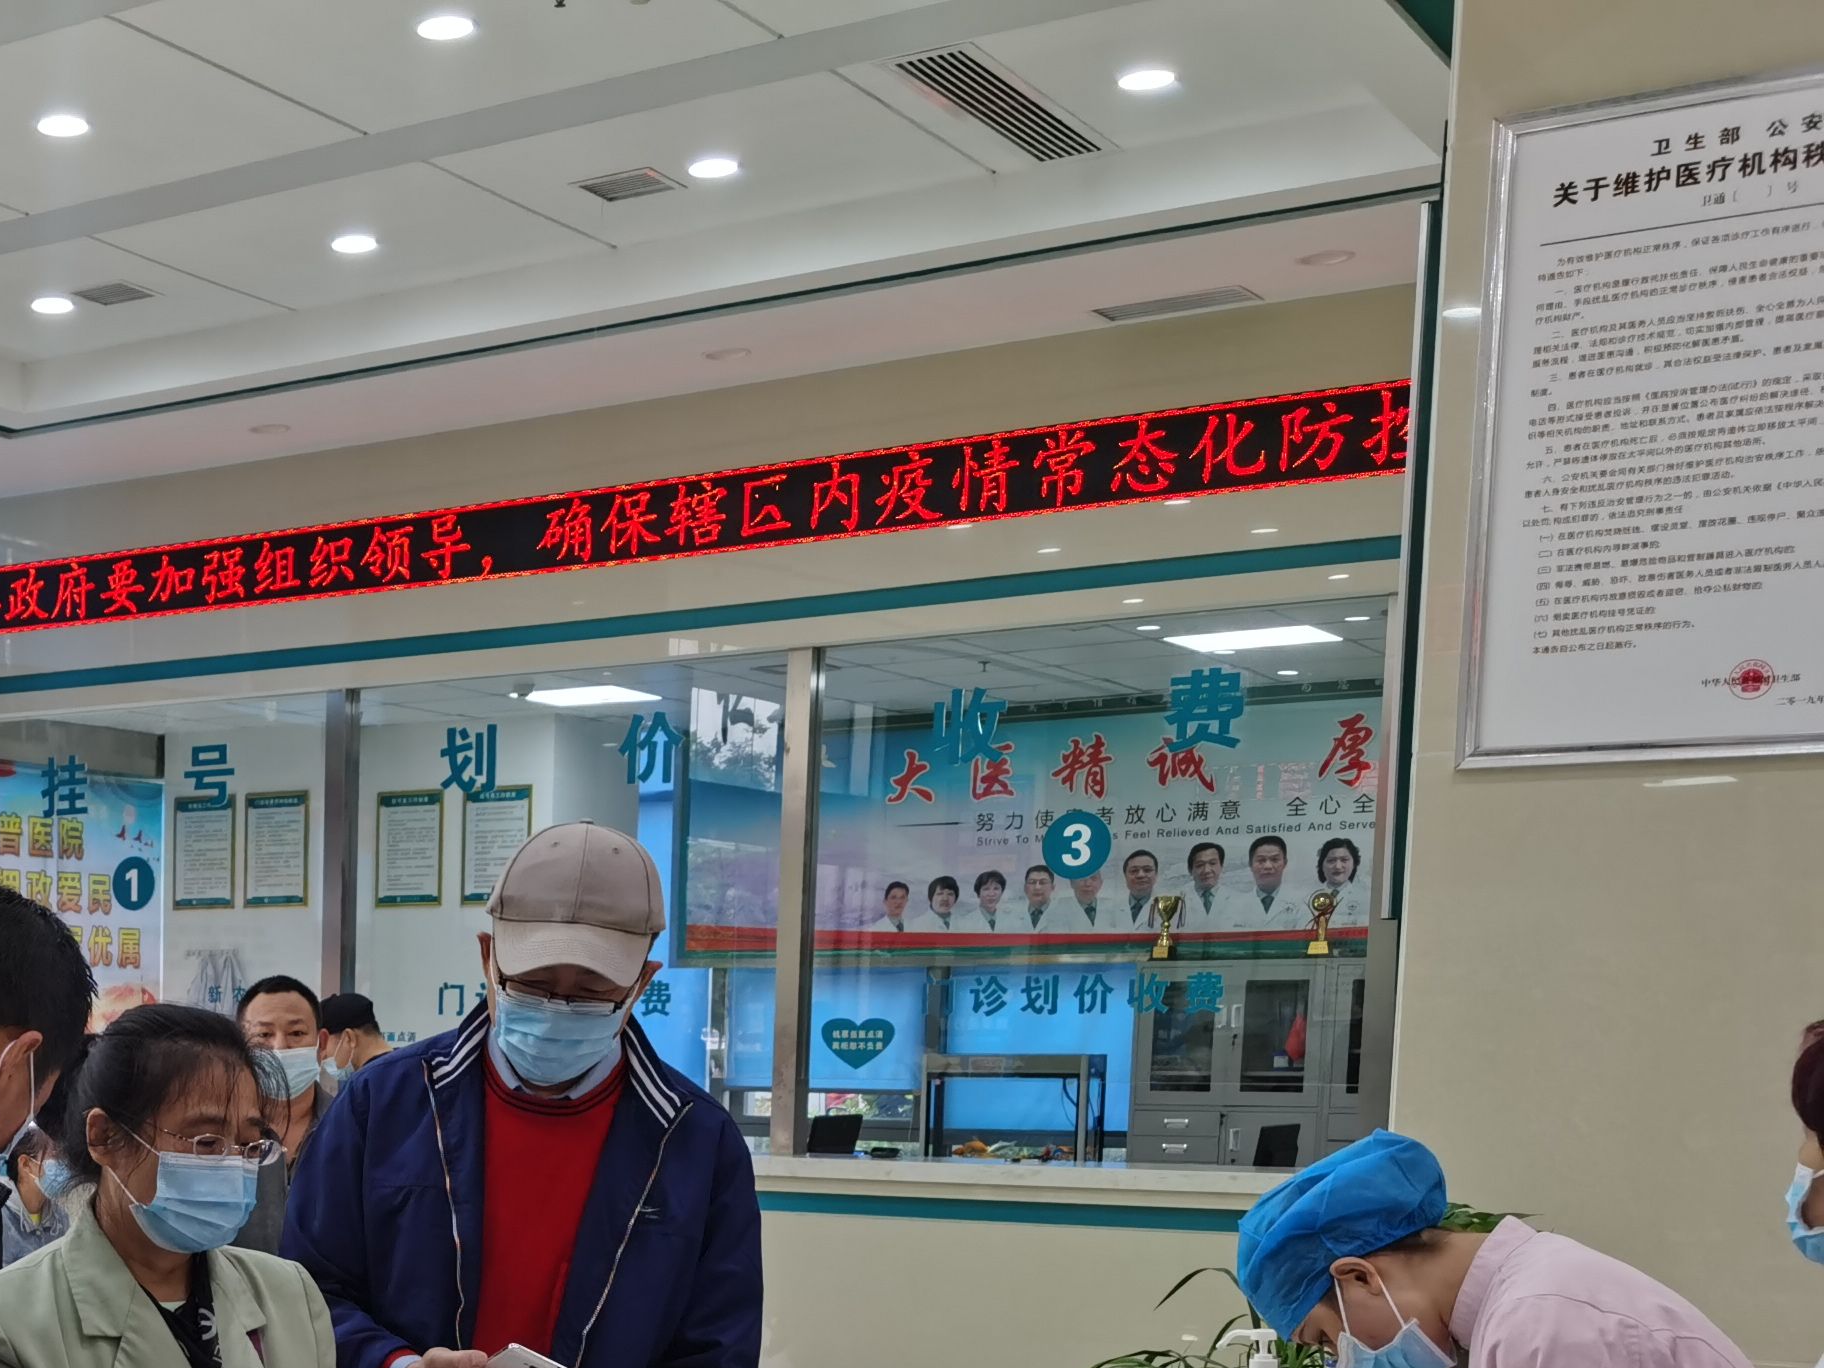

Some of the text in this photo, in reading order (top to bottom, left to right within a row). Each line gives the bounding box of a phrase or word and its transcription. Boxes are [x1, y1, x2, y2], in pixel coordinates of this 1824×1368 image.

[1650, 126, 1740, 156] 卫生部
[887, 713, 1374, 804] 大医精诚 厚
[976, 794, 1376, 833] 努力使者放心满意 全心全
[1124, 829, 1151, 840] Feel
[1157, 826, 1210, 839] Relieved
[1216, 825, 1240, 835] And
[1245, 822, 1302, 835] Satisfied
[1307, 821, 1332, 832] And
[1339, 819, 1376, 830] Serve
[1059, 822, 1093, 868] 3
[124, 868, 139, 903] 1
[640, 980, 673, 1017] 费
[923, 972, 1226, 1017] 门诊划价收费
